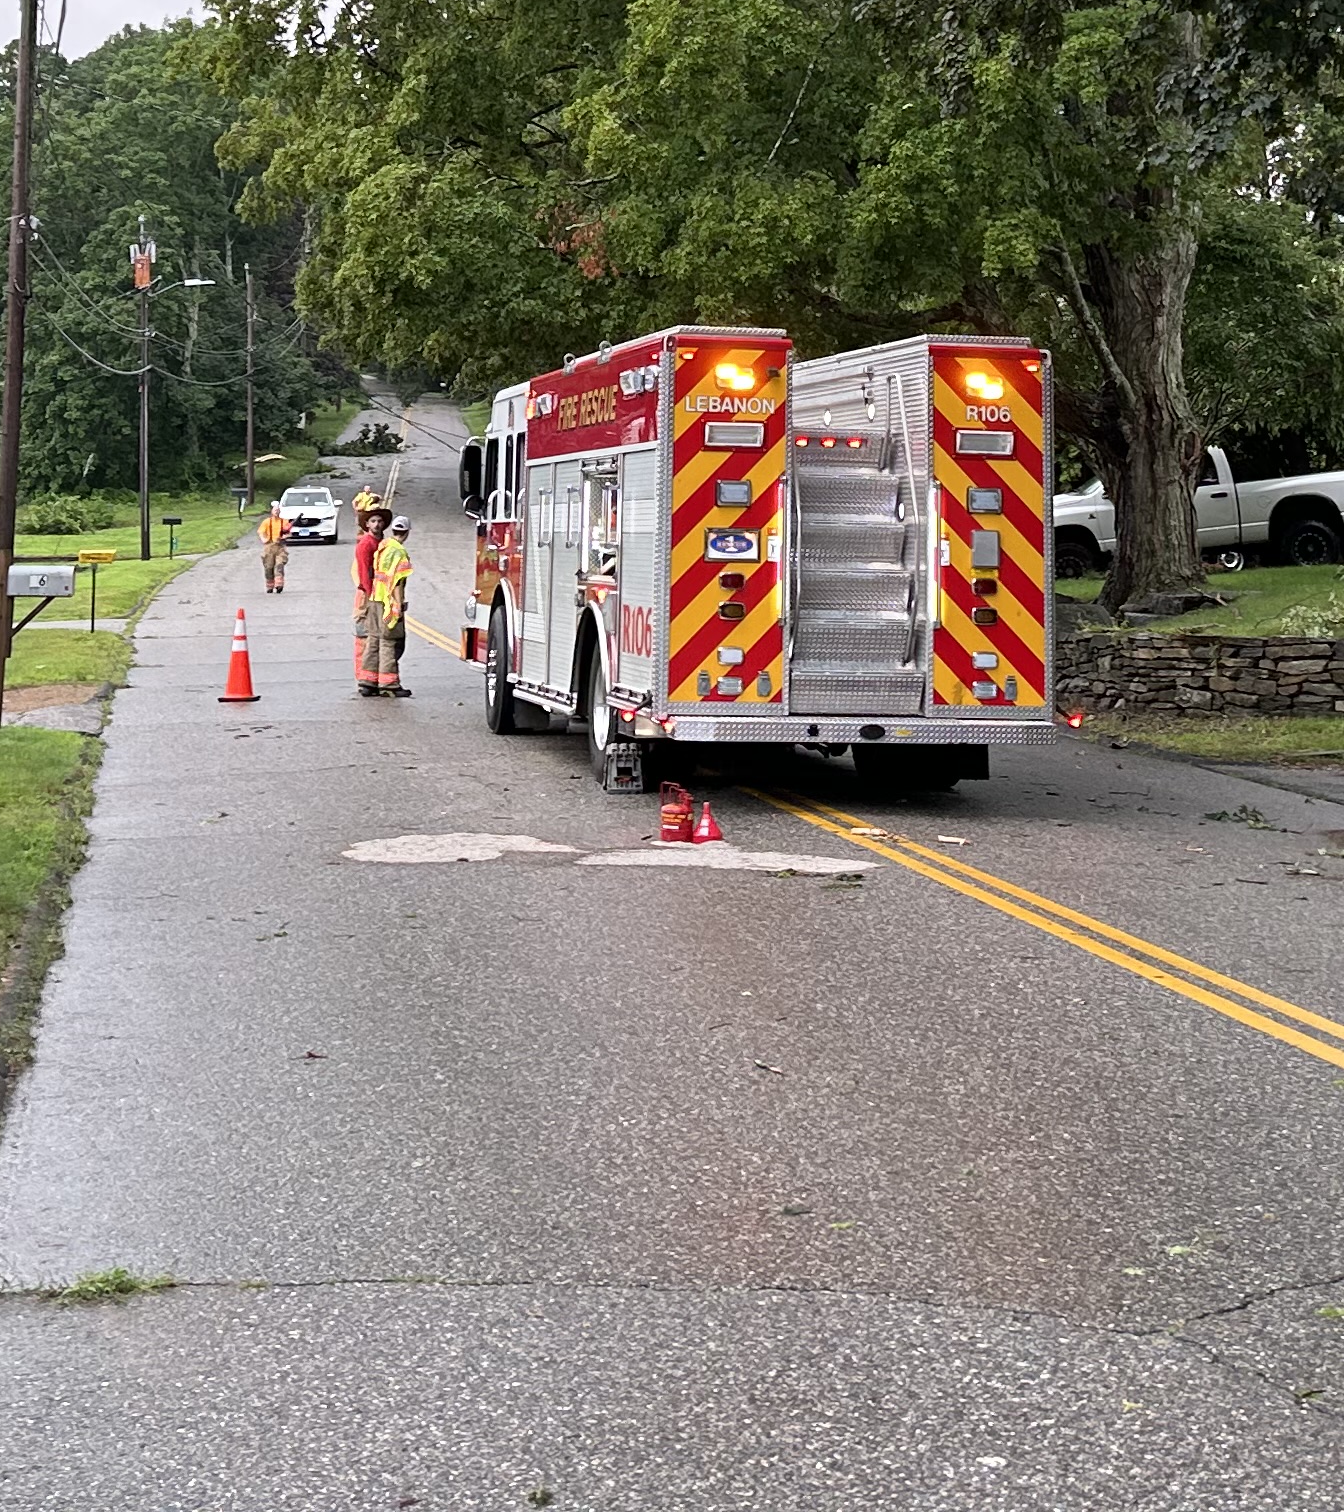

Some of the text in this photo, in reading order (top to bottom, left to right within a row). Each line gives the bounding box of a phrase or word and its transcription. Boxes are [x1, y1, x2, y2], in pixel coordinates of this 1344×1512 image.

[557, 384, 618, 432] FIRE RESCUE
[685, 395, 775, 414] LEBANON
[966, 405, 1011, 422] R106
[39, 575, 46, 586] 6
[623, 604, 652, 659] R106
